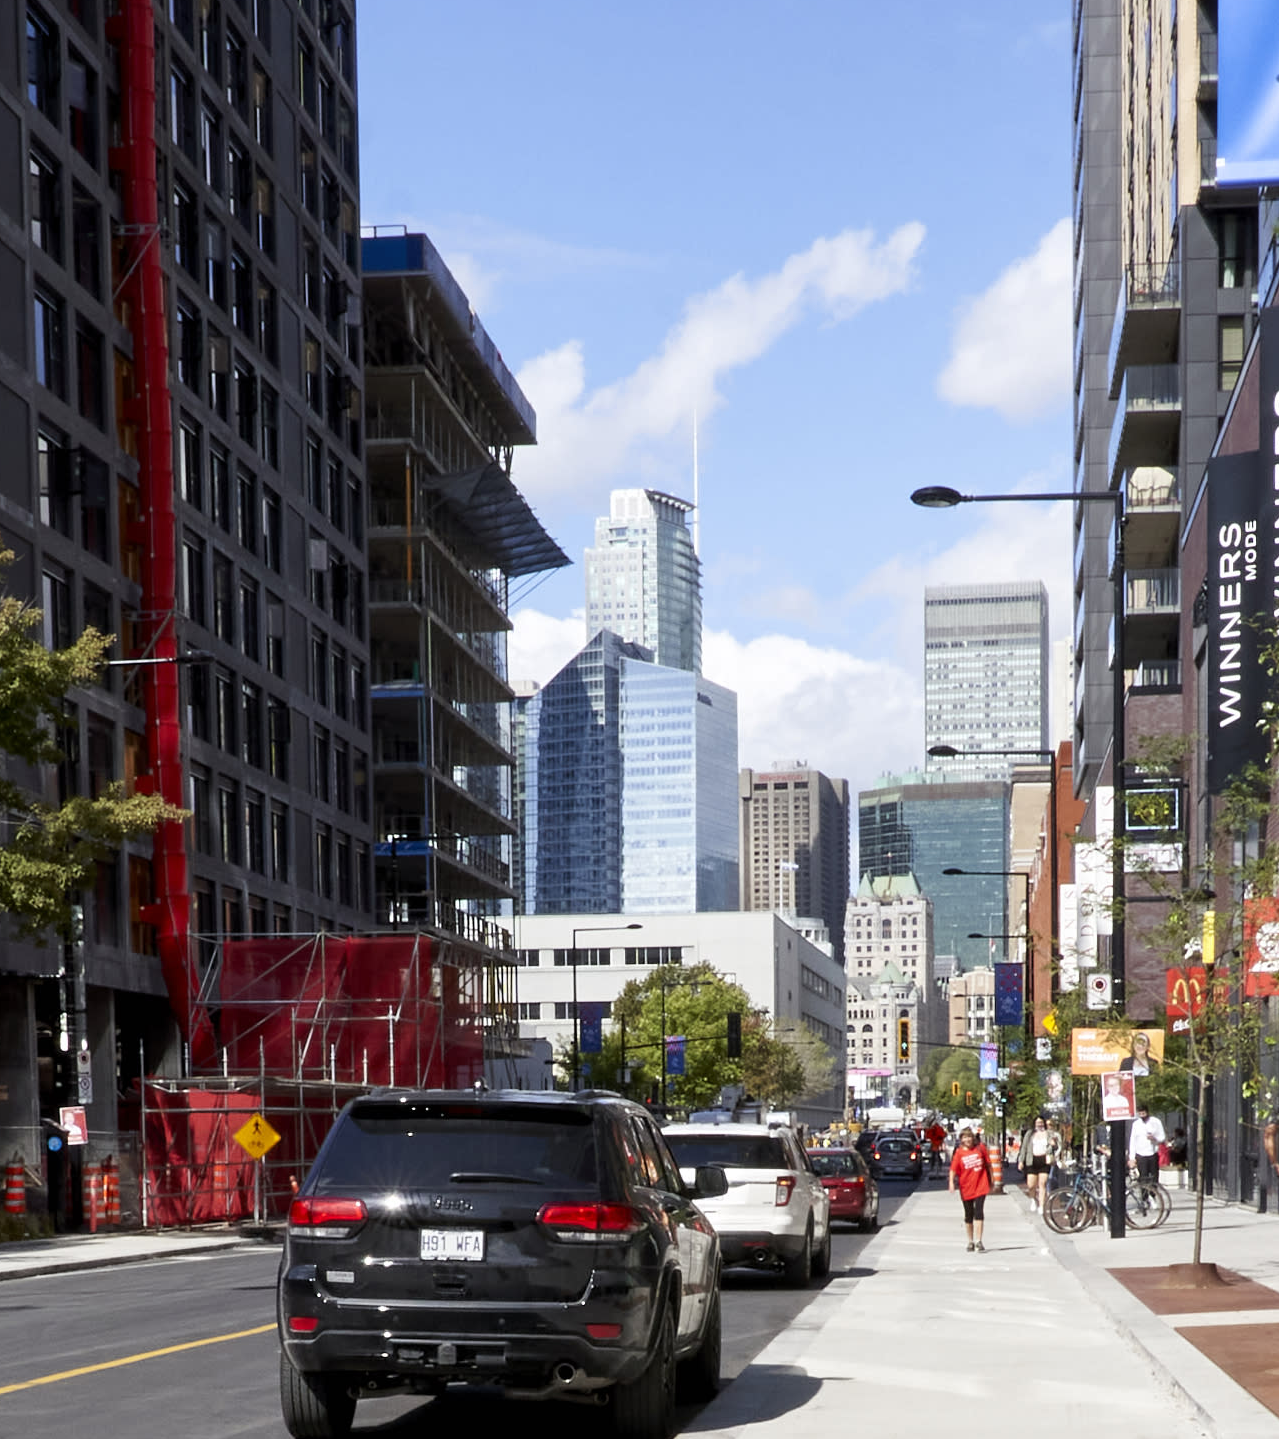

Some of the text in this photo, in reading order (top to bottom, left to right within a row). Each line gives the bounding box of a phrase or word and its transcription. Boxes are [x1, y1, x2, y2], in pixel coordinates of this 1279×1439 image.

[1244, 518, 1258, 582] MODE
[1219, 520, 1242, 728] WINNERS
[422, 1235, 481, 1251] H91 WFA
